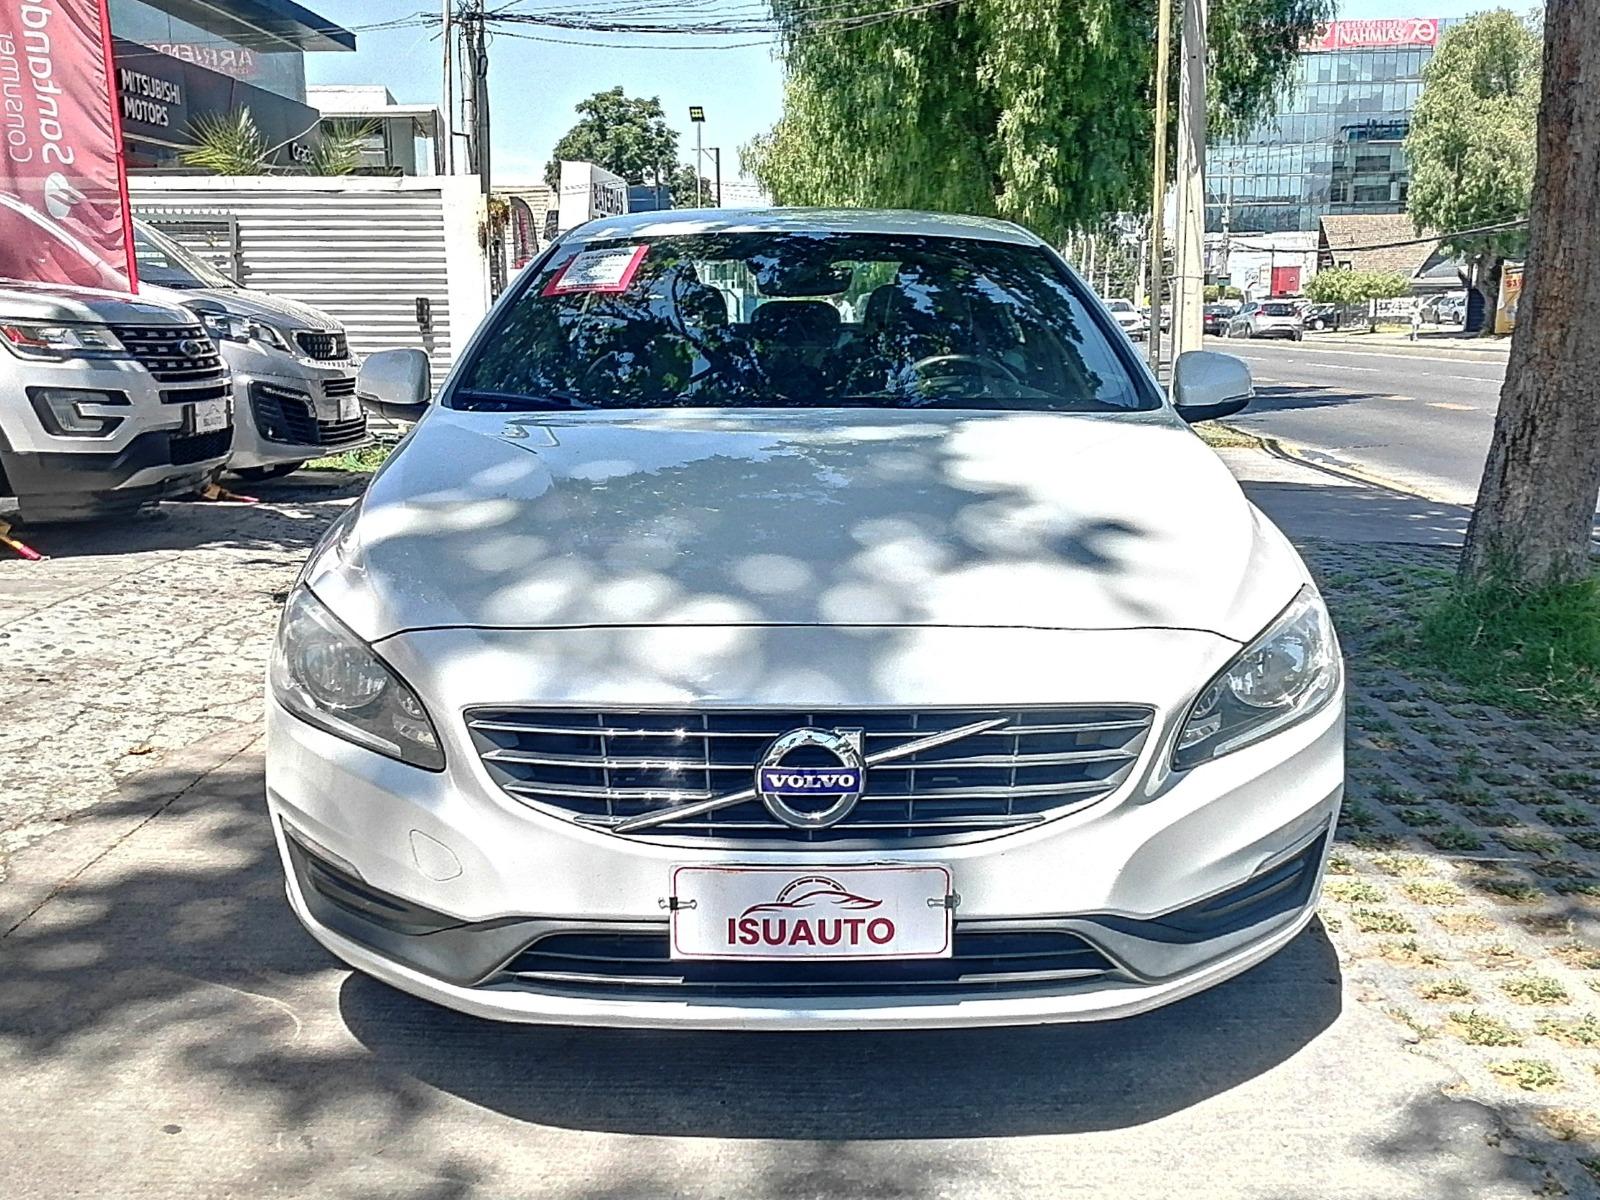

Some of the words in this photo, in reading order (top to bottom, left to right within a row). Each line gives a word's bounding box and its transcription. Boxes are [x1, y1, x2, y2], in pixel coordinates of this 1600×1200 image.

[1339, 26, 1404, 43] NAHMIAS
[121, 68, 181, 105] MITSUBISHI
[123, 96, 169, 127] MOTORS
[766, 774, 855, 788] VOLVO
[727, 918, 895, 946] ISUAUTO
